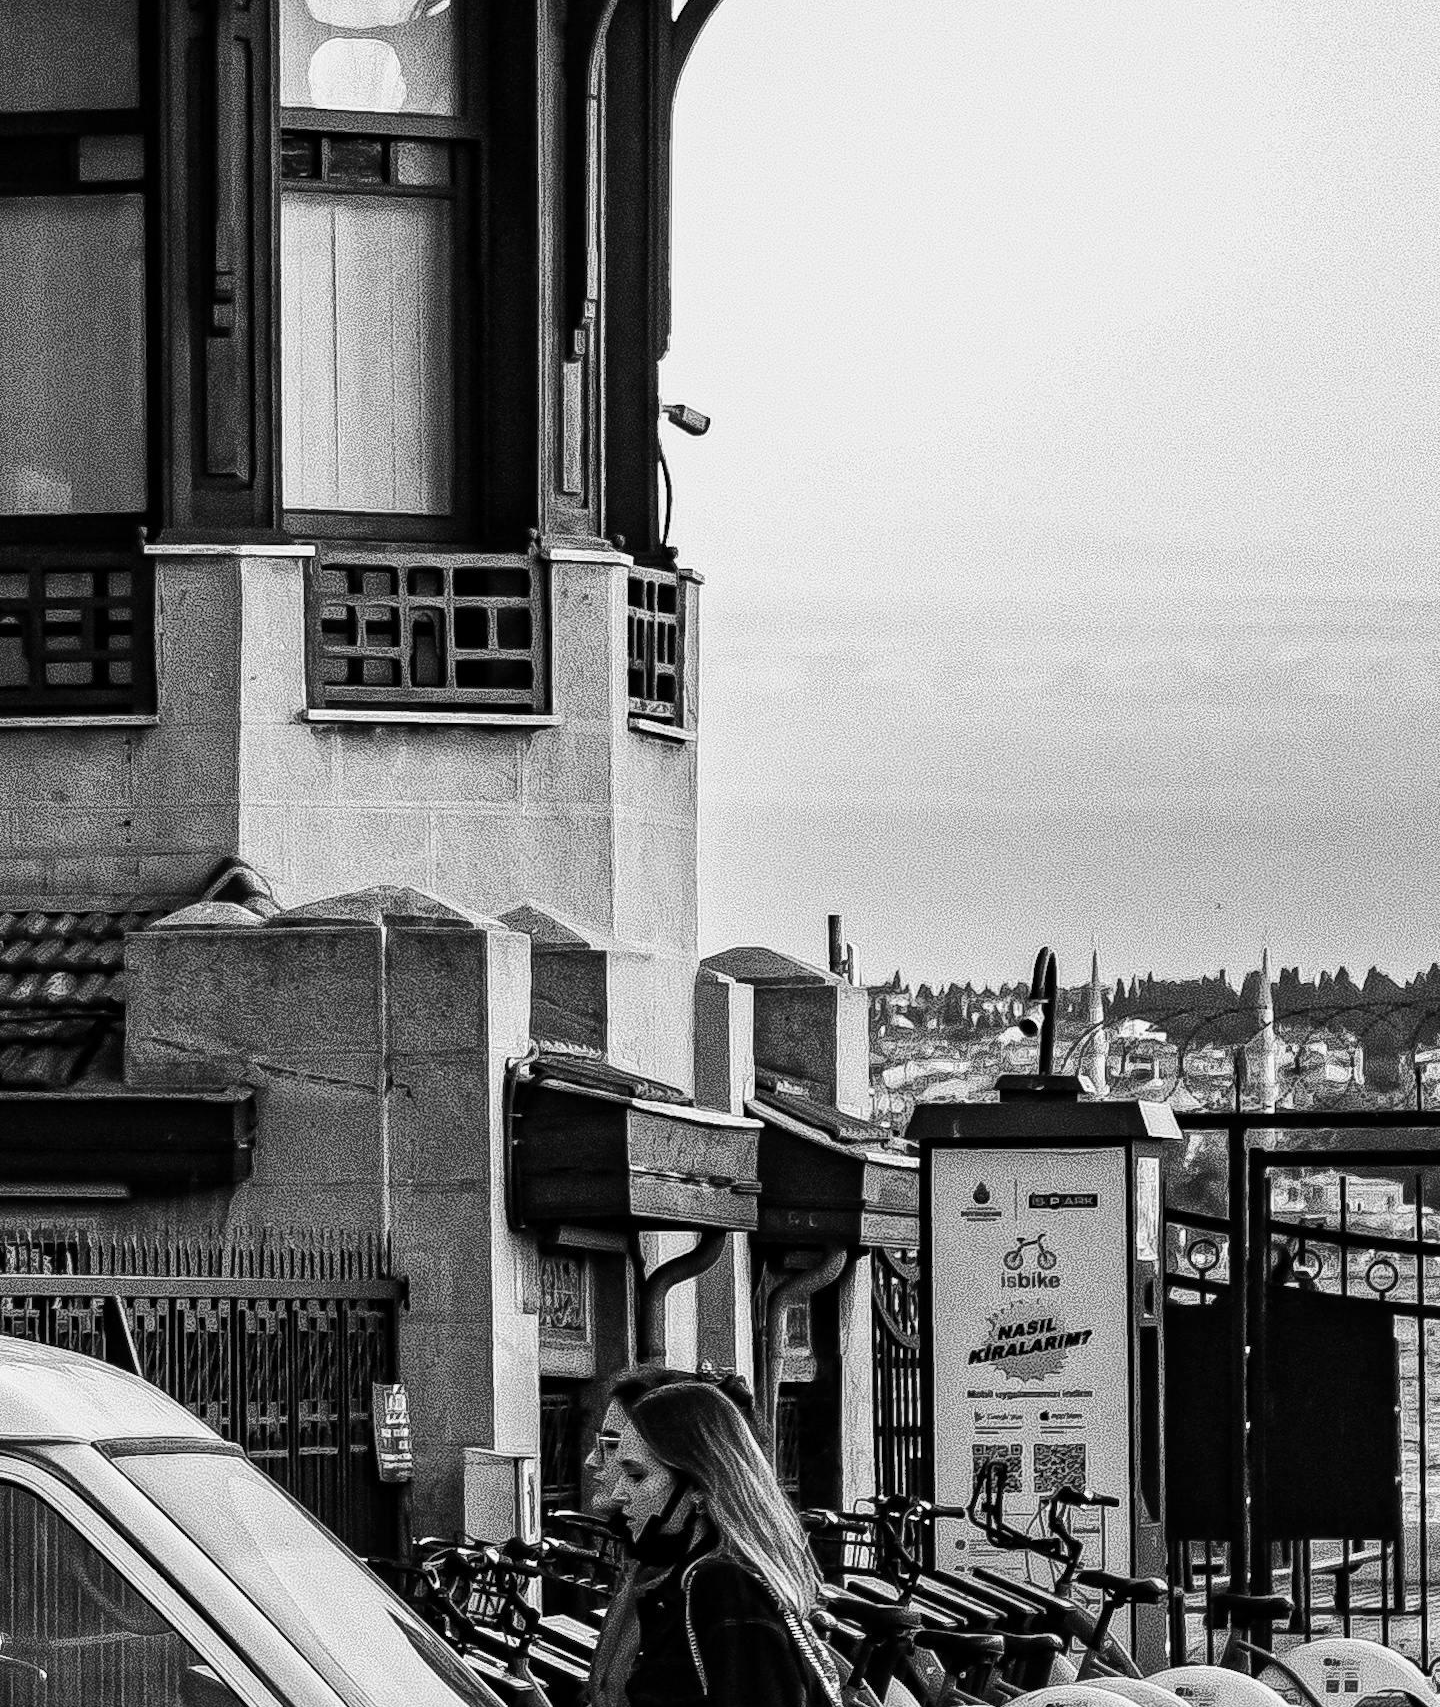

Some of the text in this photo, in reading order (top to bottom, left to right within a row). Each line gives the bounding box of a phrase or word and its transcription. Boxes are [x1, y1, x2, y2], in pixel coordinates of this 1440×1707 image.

[1001, 1272, 1060, 1289] isbike
[998, 1318, 1058, 1340] NASIL
[968, 1329, 1093, 1365] KİRALARIM?
